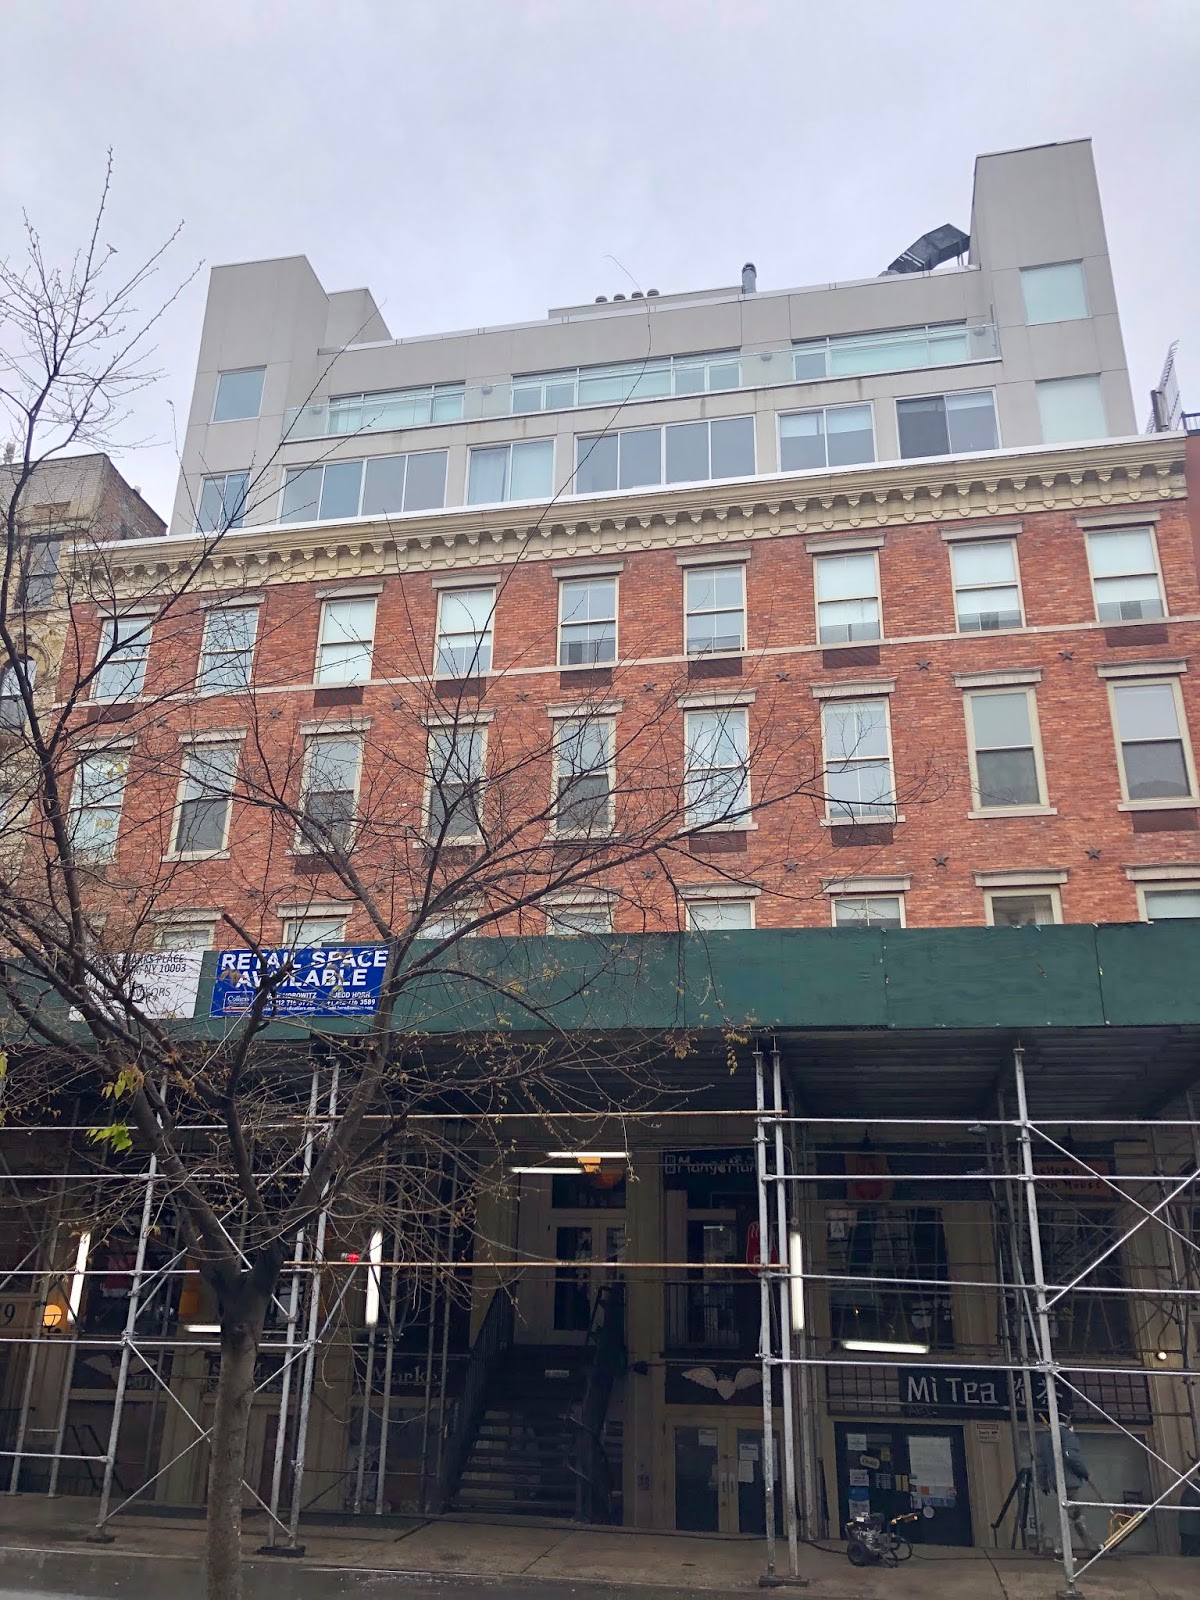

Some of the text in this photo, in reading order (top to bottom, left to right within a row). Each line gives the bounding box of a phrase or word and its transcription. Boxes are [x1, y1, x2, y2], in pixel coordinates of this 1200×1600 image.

[156, 954, 185, 964] PLACE
[221, 950, 389, 970] RETAIL SPACE
[160, 963, 187, 973] 10003
[235, 969, 368, 989] AVLABLE
[359, 998, 376, 1006] 3589
[907, 1376, 999, 1404] Mi Tea
